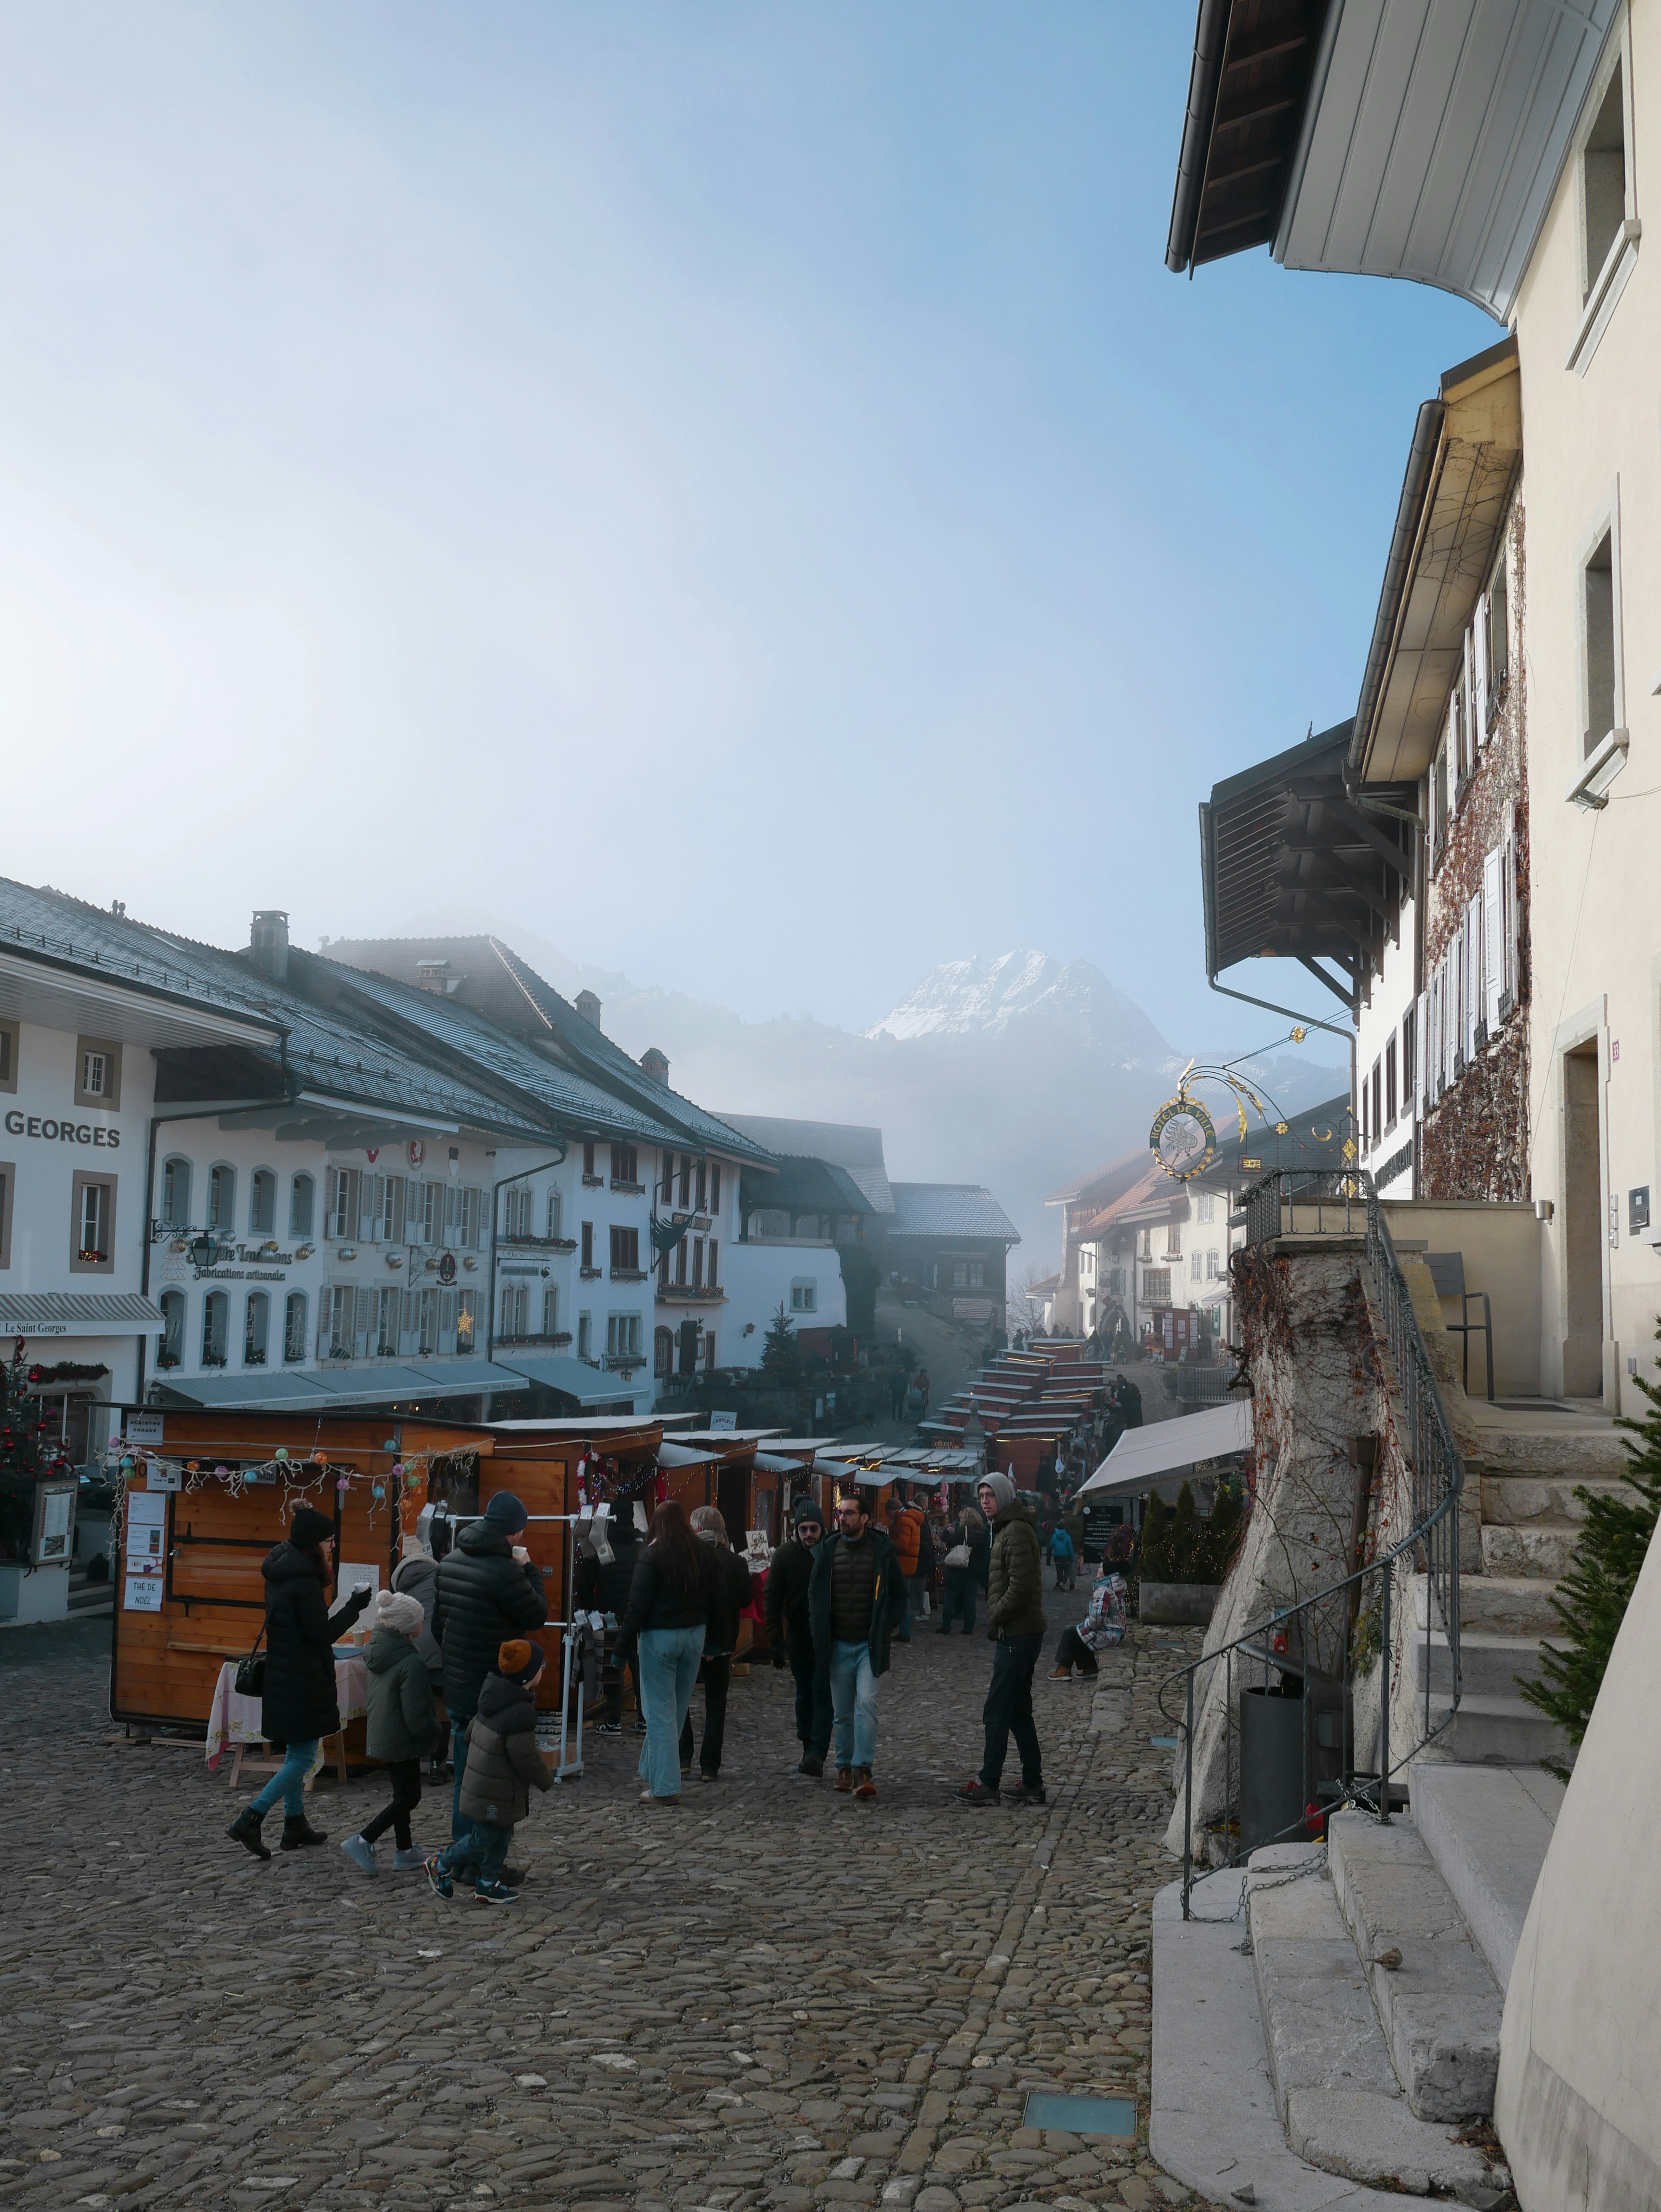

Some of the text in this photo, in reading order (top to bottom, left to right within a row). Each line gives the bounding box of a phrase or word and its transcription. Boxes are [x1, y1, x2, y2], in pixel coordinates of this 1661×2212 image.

[1613, 1043, 1618, 1059] 33
[1151, 1105, 1213, 1139] HOTEL DE VILLE
[5, 1110, 120, 1148] GEORGES
[193, 1267, 286, 1281] Fabrications artisanales
[5, 1323, 15, 1333] Le
[16, 1323, 36, 1333] Saint
[38, 1323, 66, 1335] Georges
[258, 1472, 275, 1481] HAUD
[133, 1581, 156, 1592] THÉ DE
[135, 1595, 151, 1605] NOËL
